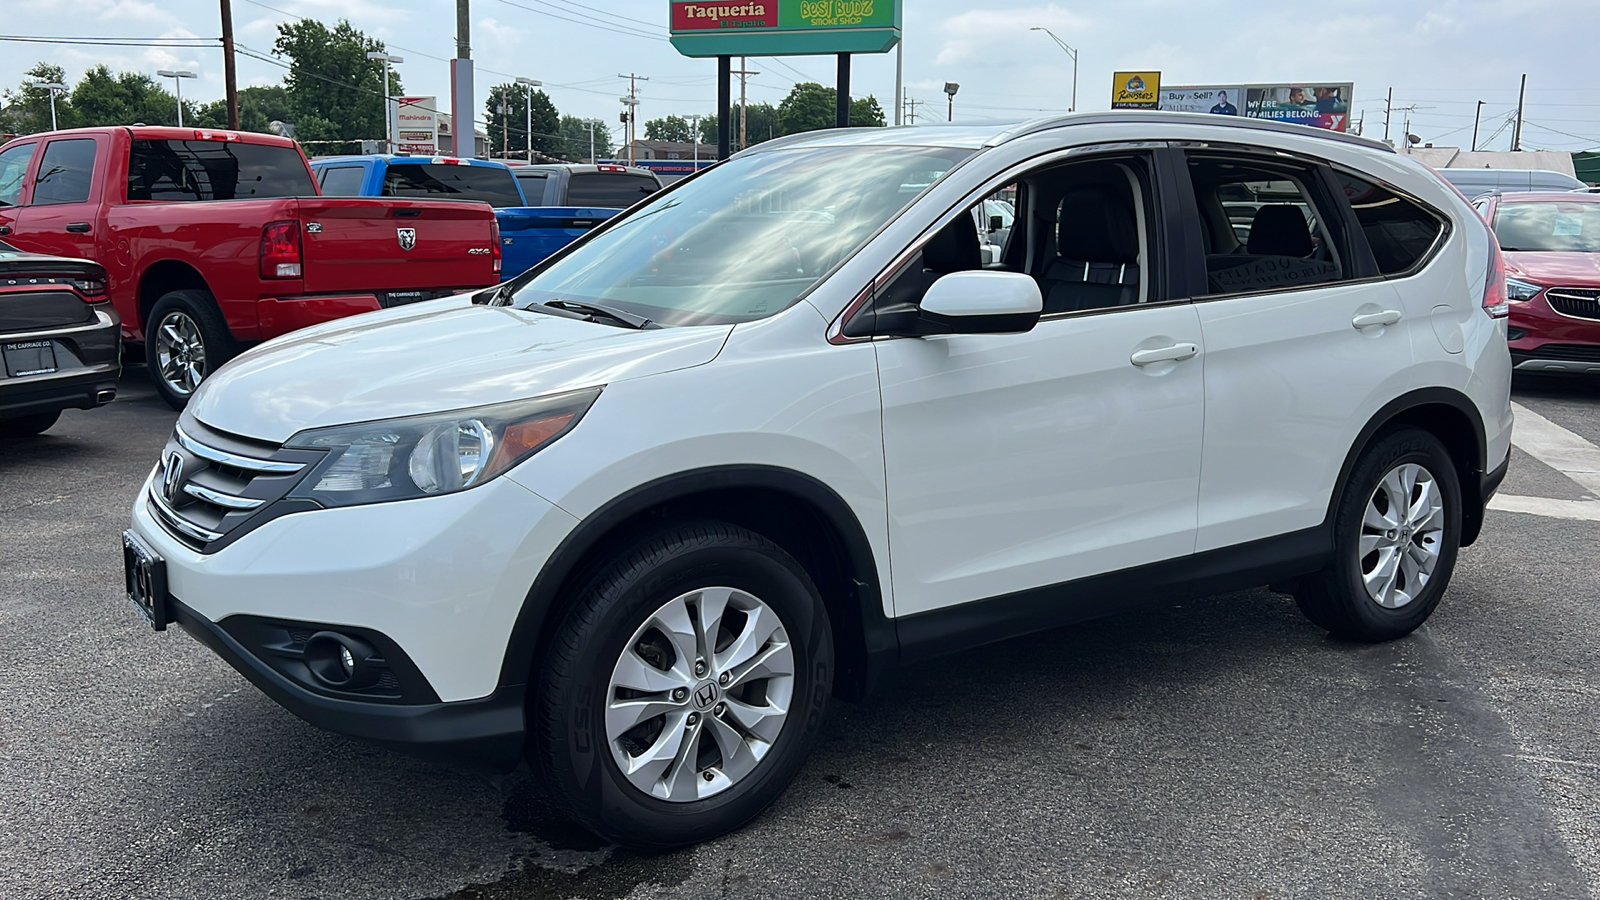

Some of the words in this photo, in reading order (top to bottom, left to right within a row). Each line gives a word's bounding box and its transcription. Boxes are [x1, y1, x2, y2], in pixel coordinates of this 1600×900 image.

[811, 18, 838, 26] SMOKE
[839, 17, 862, 25] SHOP
[1118, 90, 1154, 101] Roosters
[1169, 92, 1185, 101] Buy
[1193, 91, 1213, 100] Sell?
[1286, 110, 1321, 118] BELONG.
